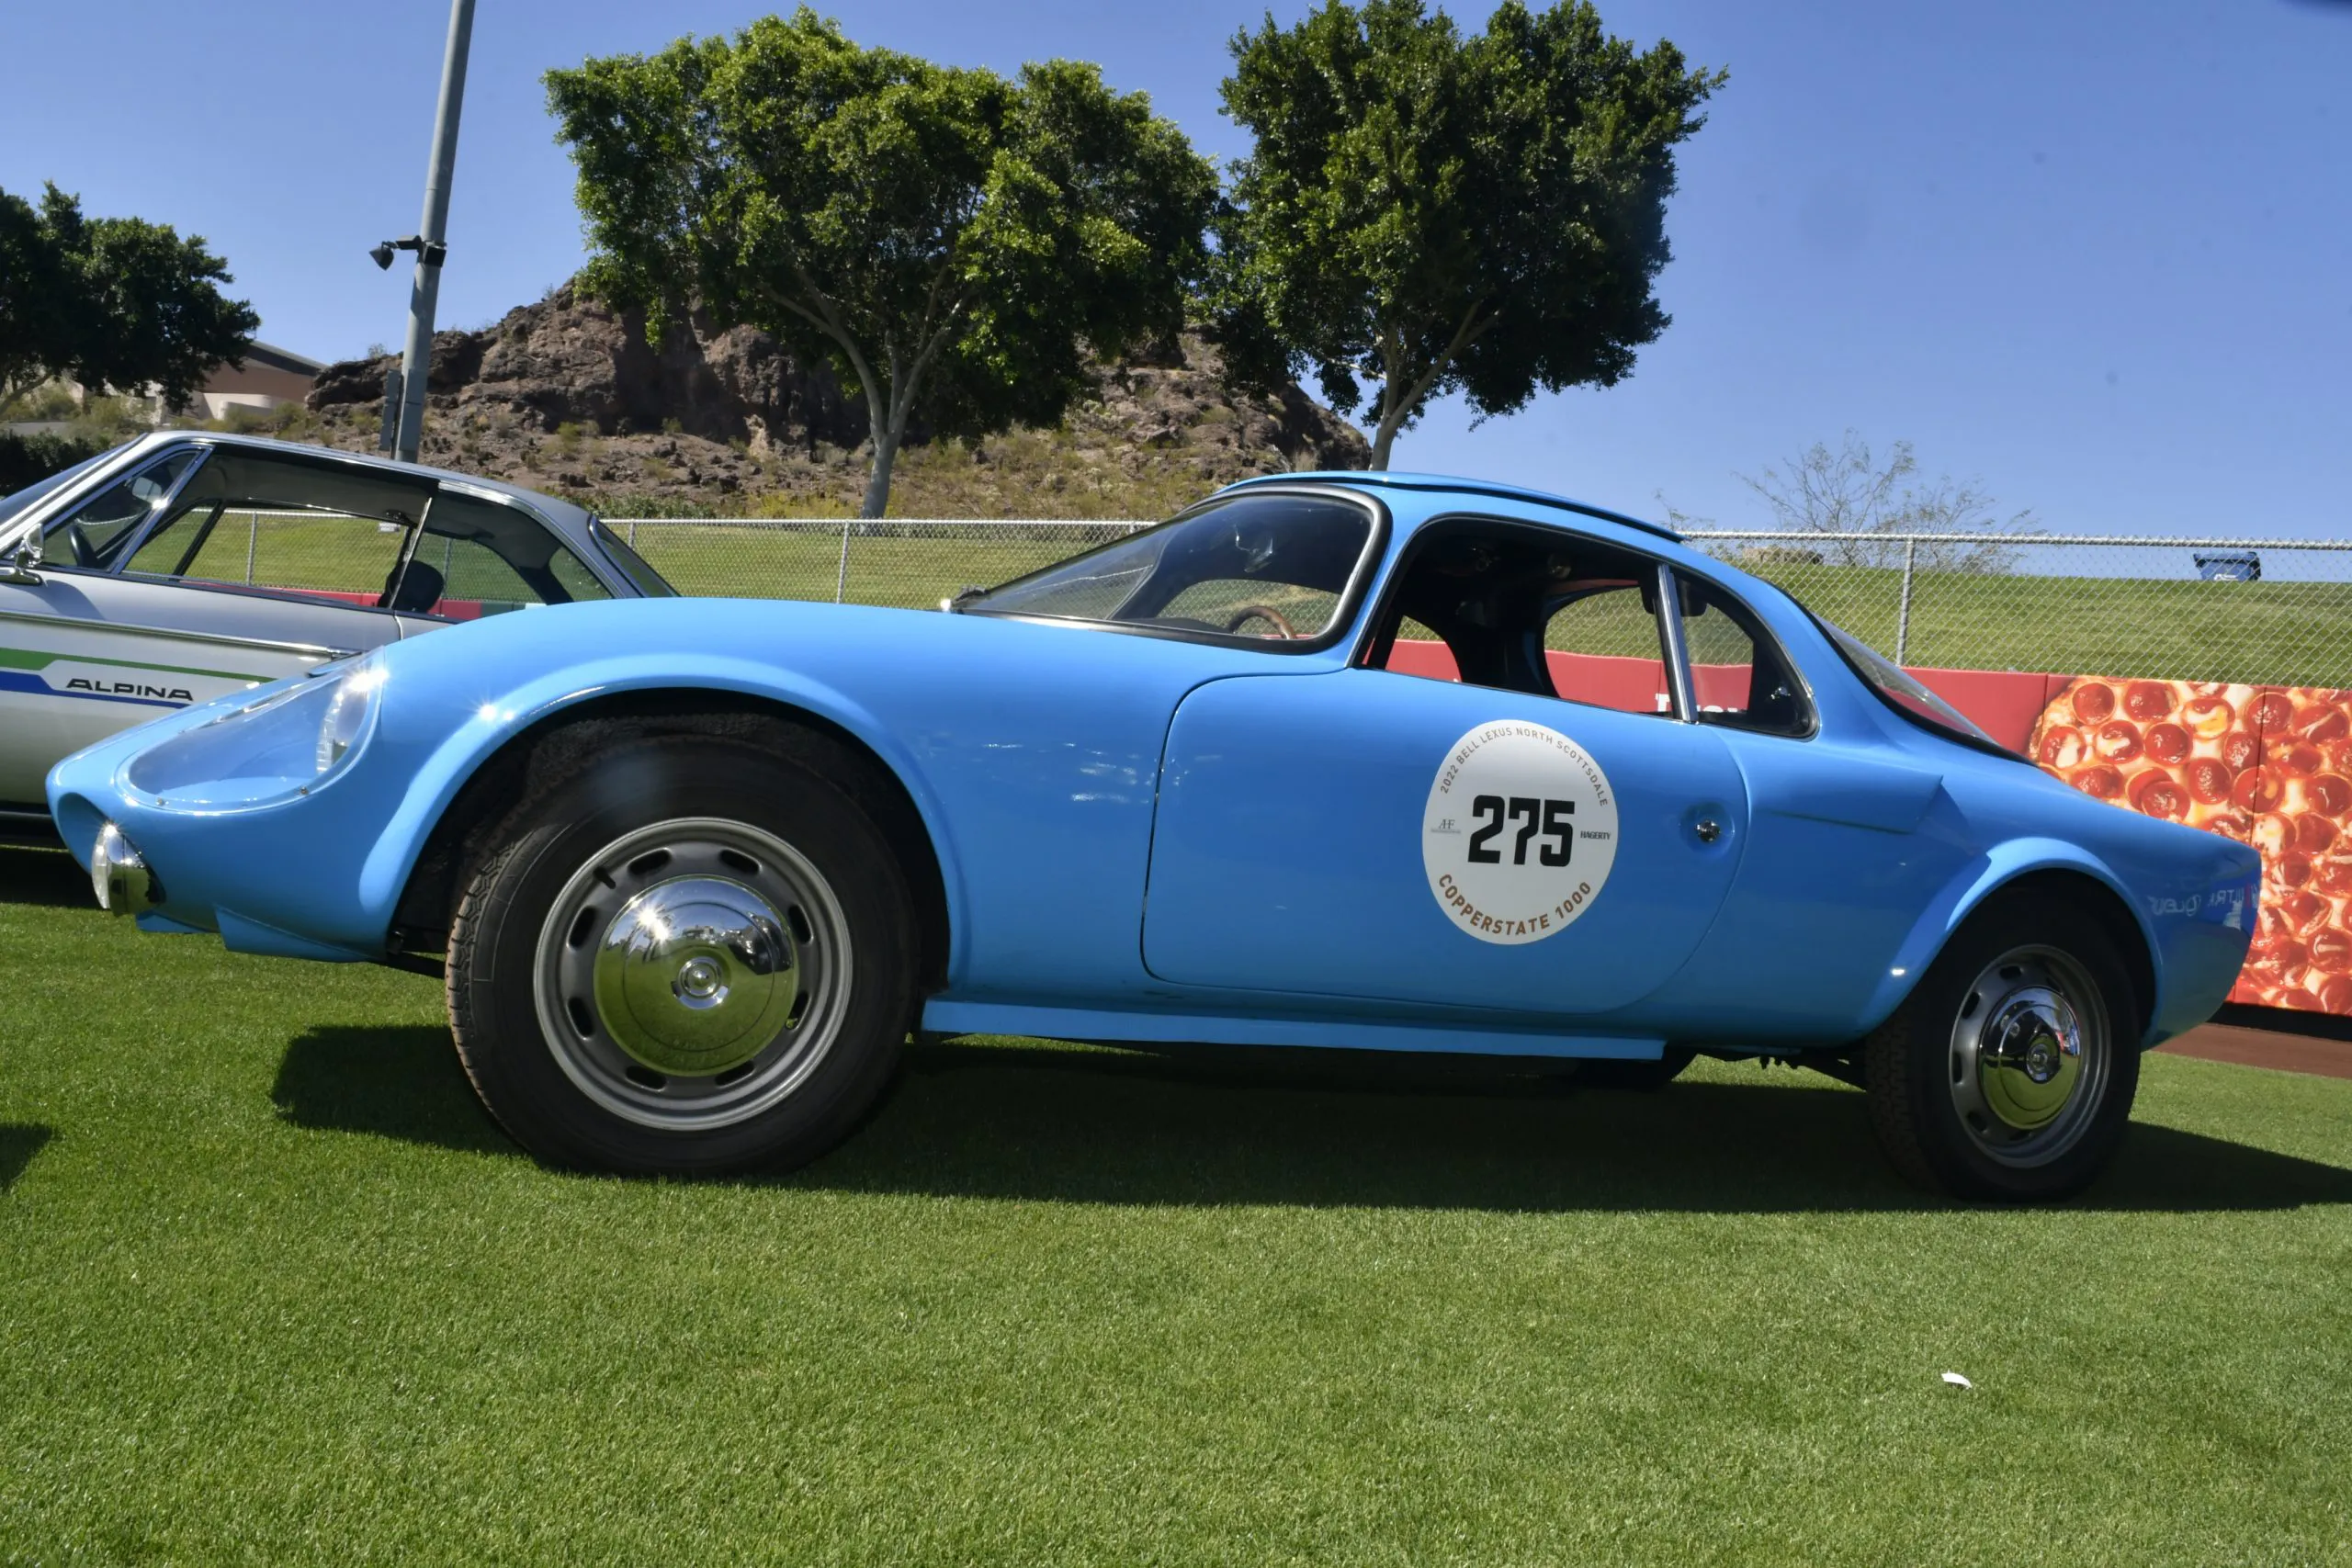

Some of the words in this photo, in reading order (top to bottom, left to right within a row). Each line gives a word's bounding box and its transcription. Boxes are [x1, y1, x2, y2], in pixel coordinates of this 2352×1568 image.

[66, 678, 193, 701] ALPINA
[1440, 764, 1459, 794] 2022
[1456, 740, 1479, 765] BELL
[1480, 727, 1512, 744] LEXUS
[1516, 728, 1553, 745] NORTH
[1556, 740, 1609, 807] SCOTTSDALE
[1467, 795, 1576, 867] 275
[1579, 830, 1611, 840] HAGERTY
[1439, 874, 1551, 936] COPPERSTATE
[1555, 882, 1591, 919] 1000
